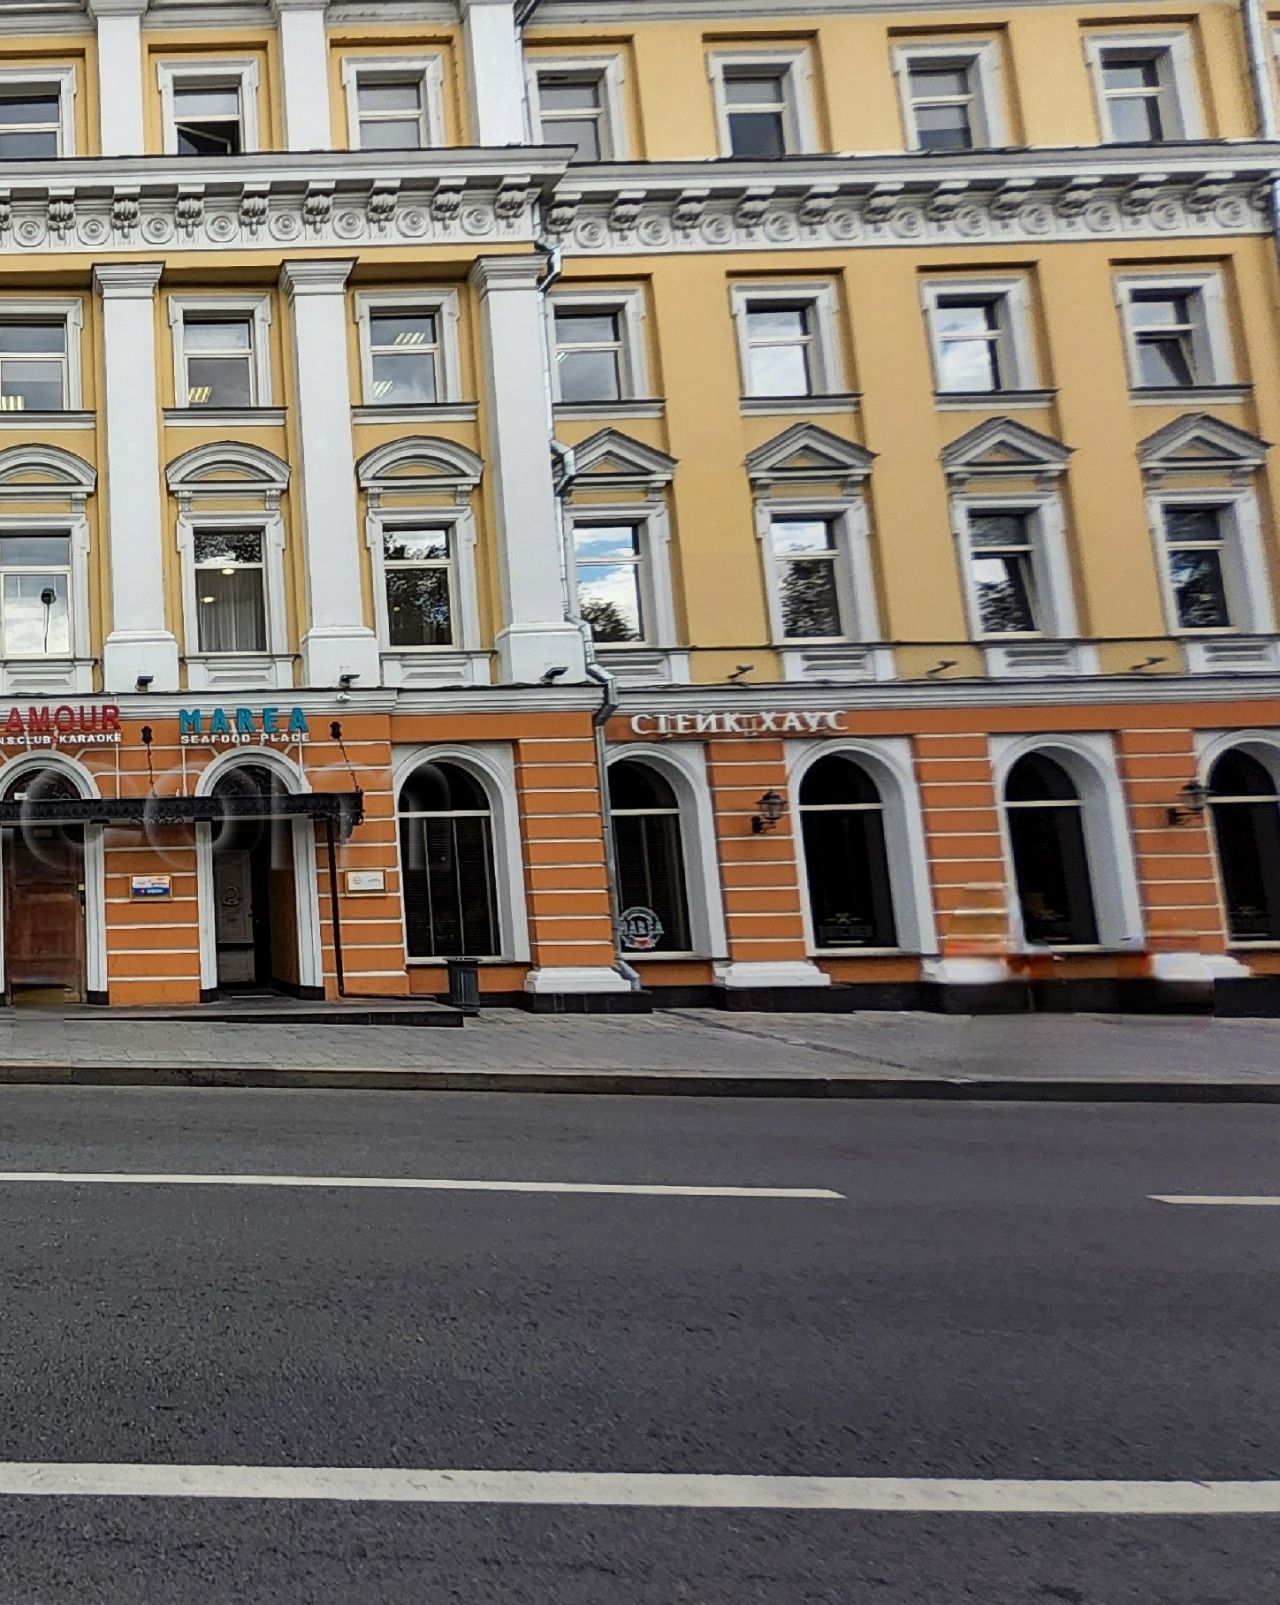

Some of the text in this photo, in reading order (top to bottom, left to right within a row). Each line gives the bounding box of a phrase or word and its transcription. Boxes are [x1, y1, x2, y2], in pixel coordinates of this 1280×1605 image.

[179, 707, 309, 734] MAREA
[758, 710, 849, 733] ХАУС
[59, 733, 122, 744] KARAOKE
[181, 733, 310, 744] SEAFOOD PLACE
